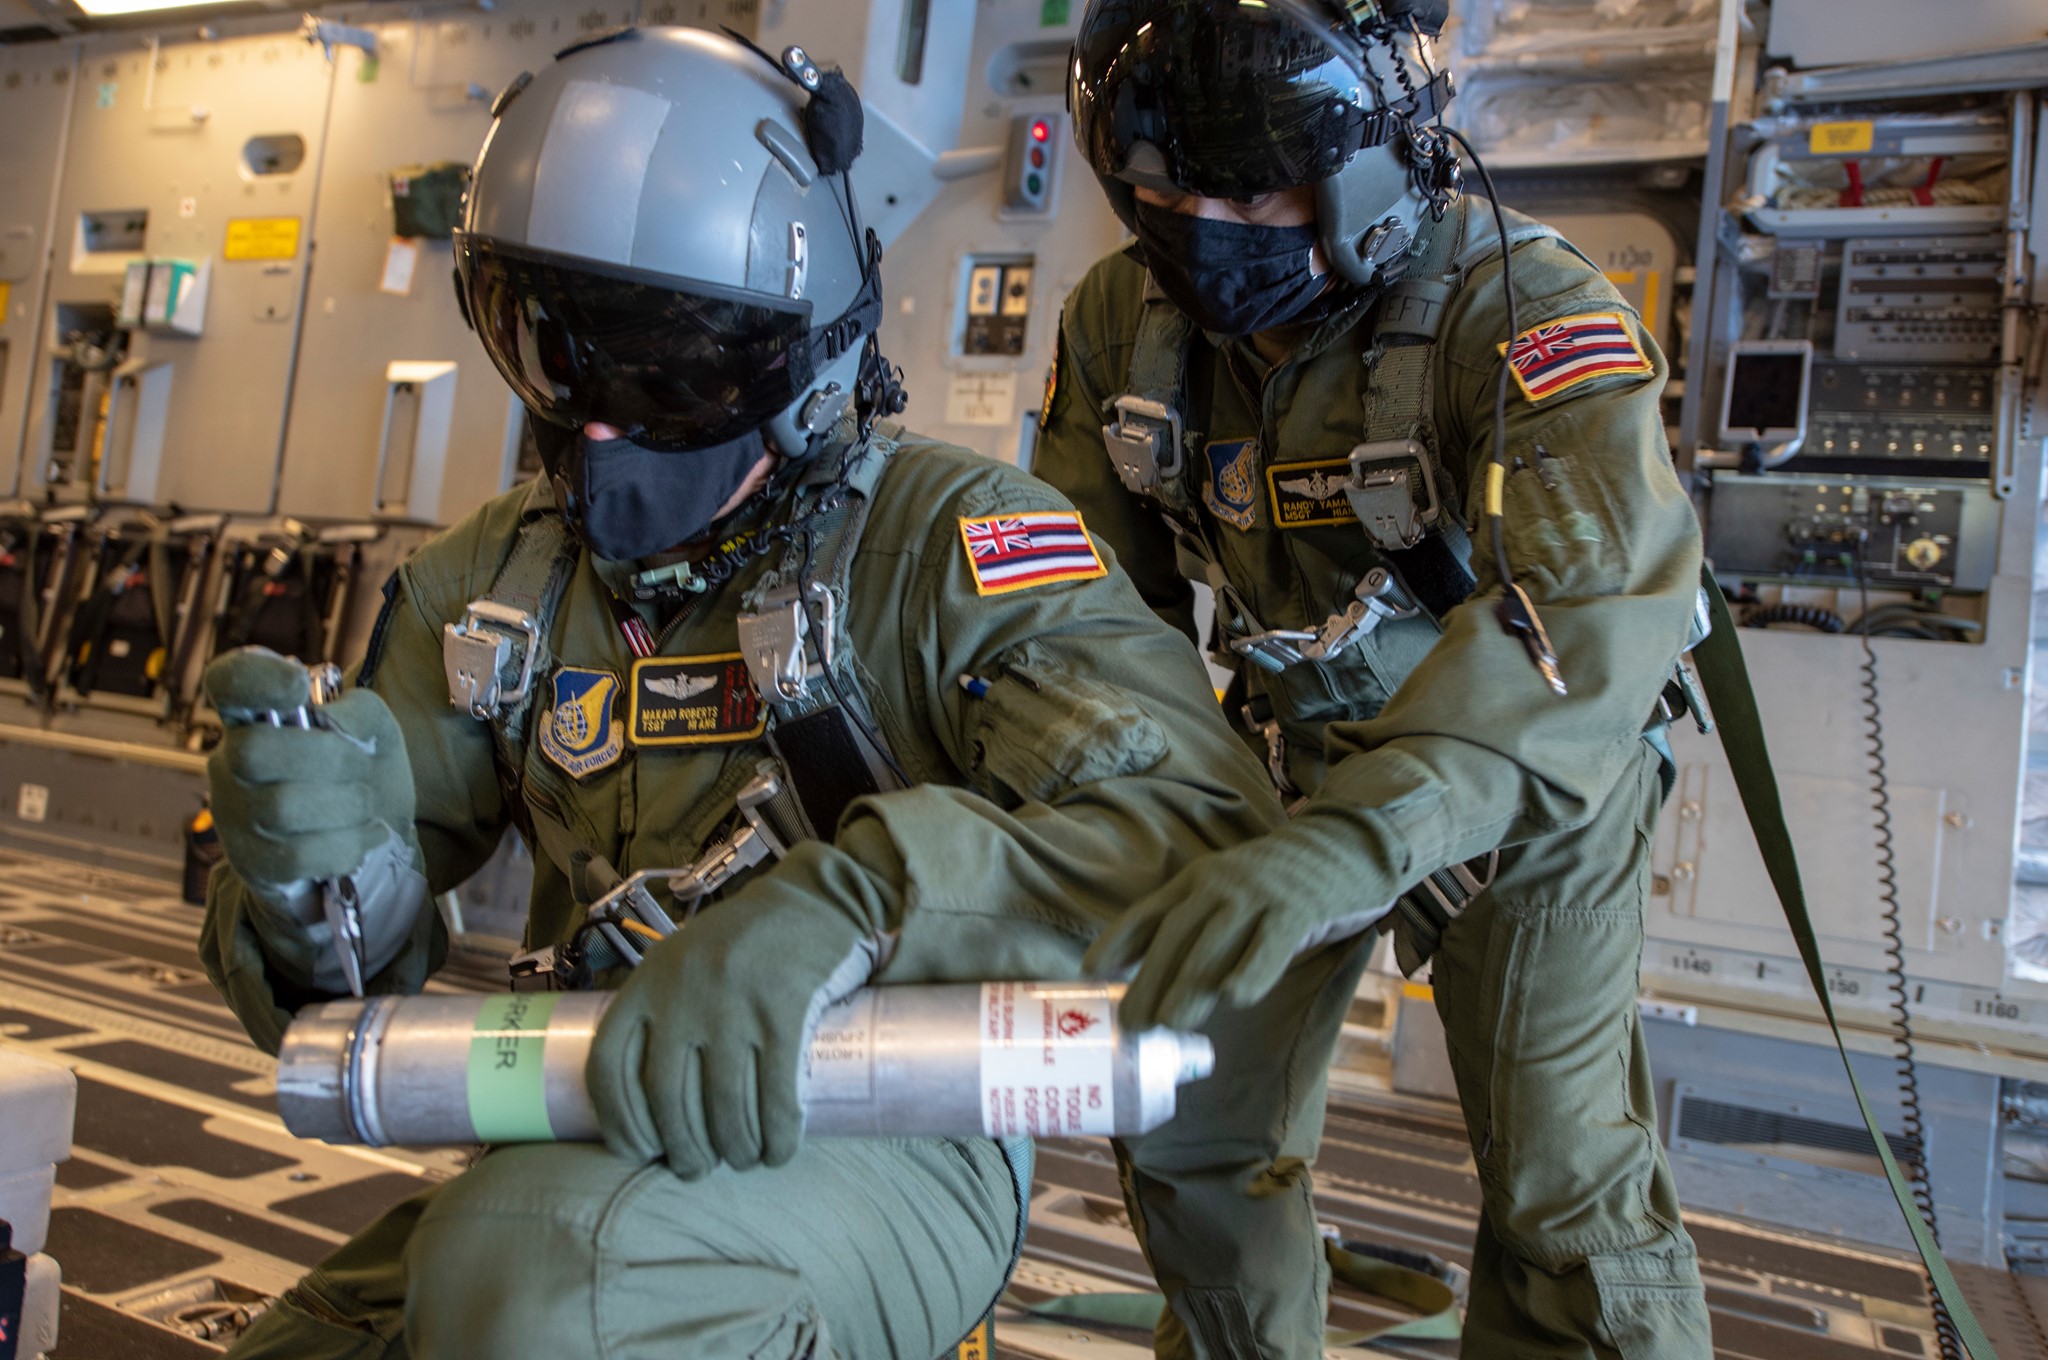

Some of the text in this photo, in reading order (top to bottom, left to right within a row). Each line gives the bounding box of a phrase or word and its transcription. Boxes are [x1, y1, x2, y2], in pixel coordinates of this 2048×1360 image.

[1376, 294, 1442, 326] EFT
[1283, 501, 1315, 511] RANDY
[1285, 510, 1311, 521] MSGT
[641, 706, 718, 721] MAKAIO ROBERTS
[642, 719, 666, 732] TSGT
[584, 743, 619, 769] FORCES
[1672, 956, 1711, 974] 1140
[1973, 999, 2020, 1020] 1160
[1088, 1085, 1102, 1109] NO
